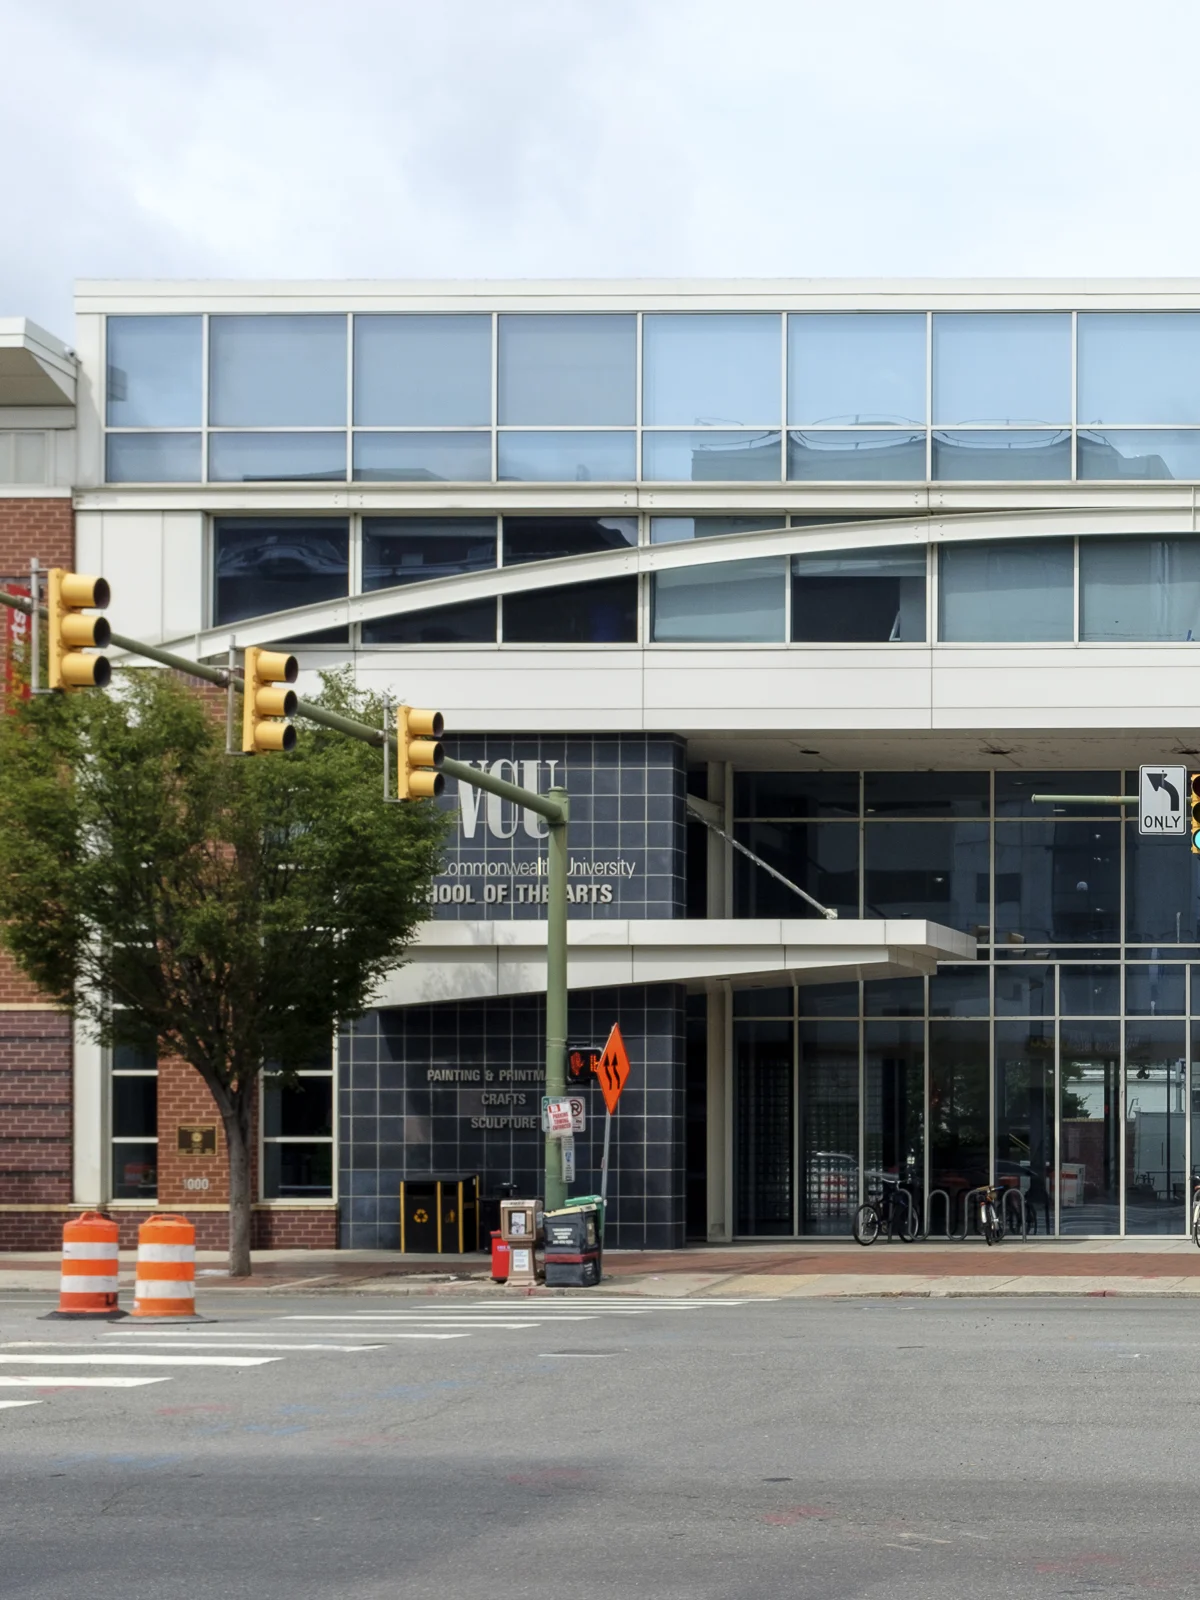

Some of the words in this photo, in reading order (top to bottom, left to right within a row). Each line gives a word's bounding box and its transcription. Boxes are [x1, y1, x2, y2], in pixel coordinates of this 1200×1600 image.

[457, 758, 559, 839] VCU
[1143, 816, 1182, 829] ONLY
[484, 883, 507, 903] OF
[516, 884, 549, 904] THE
[566, 884, 613, 904] ARTS
[427, 1069, 481, 1081] PAINTING
[484, 1070, 494, 1081] &
[499, 1069, 546, 1081] PRINTM
[481, 1093, 526, 1105] CRAFTS
[471, 1117, 537, 1129] SCULPTURE
[183, 1178, 209, 1190] 1000
